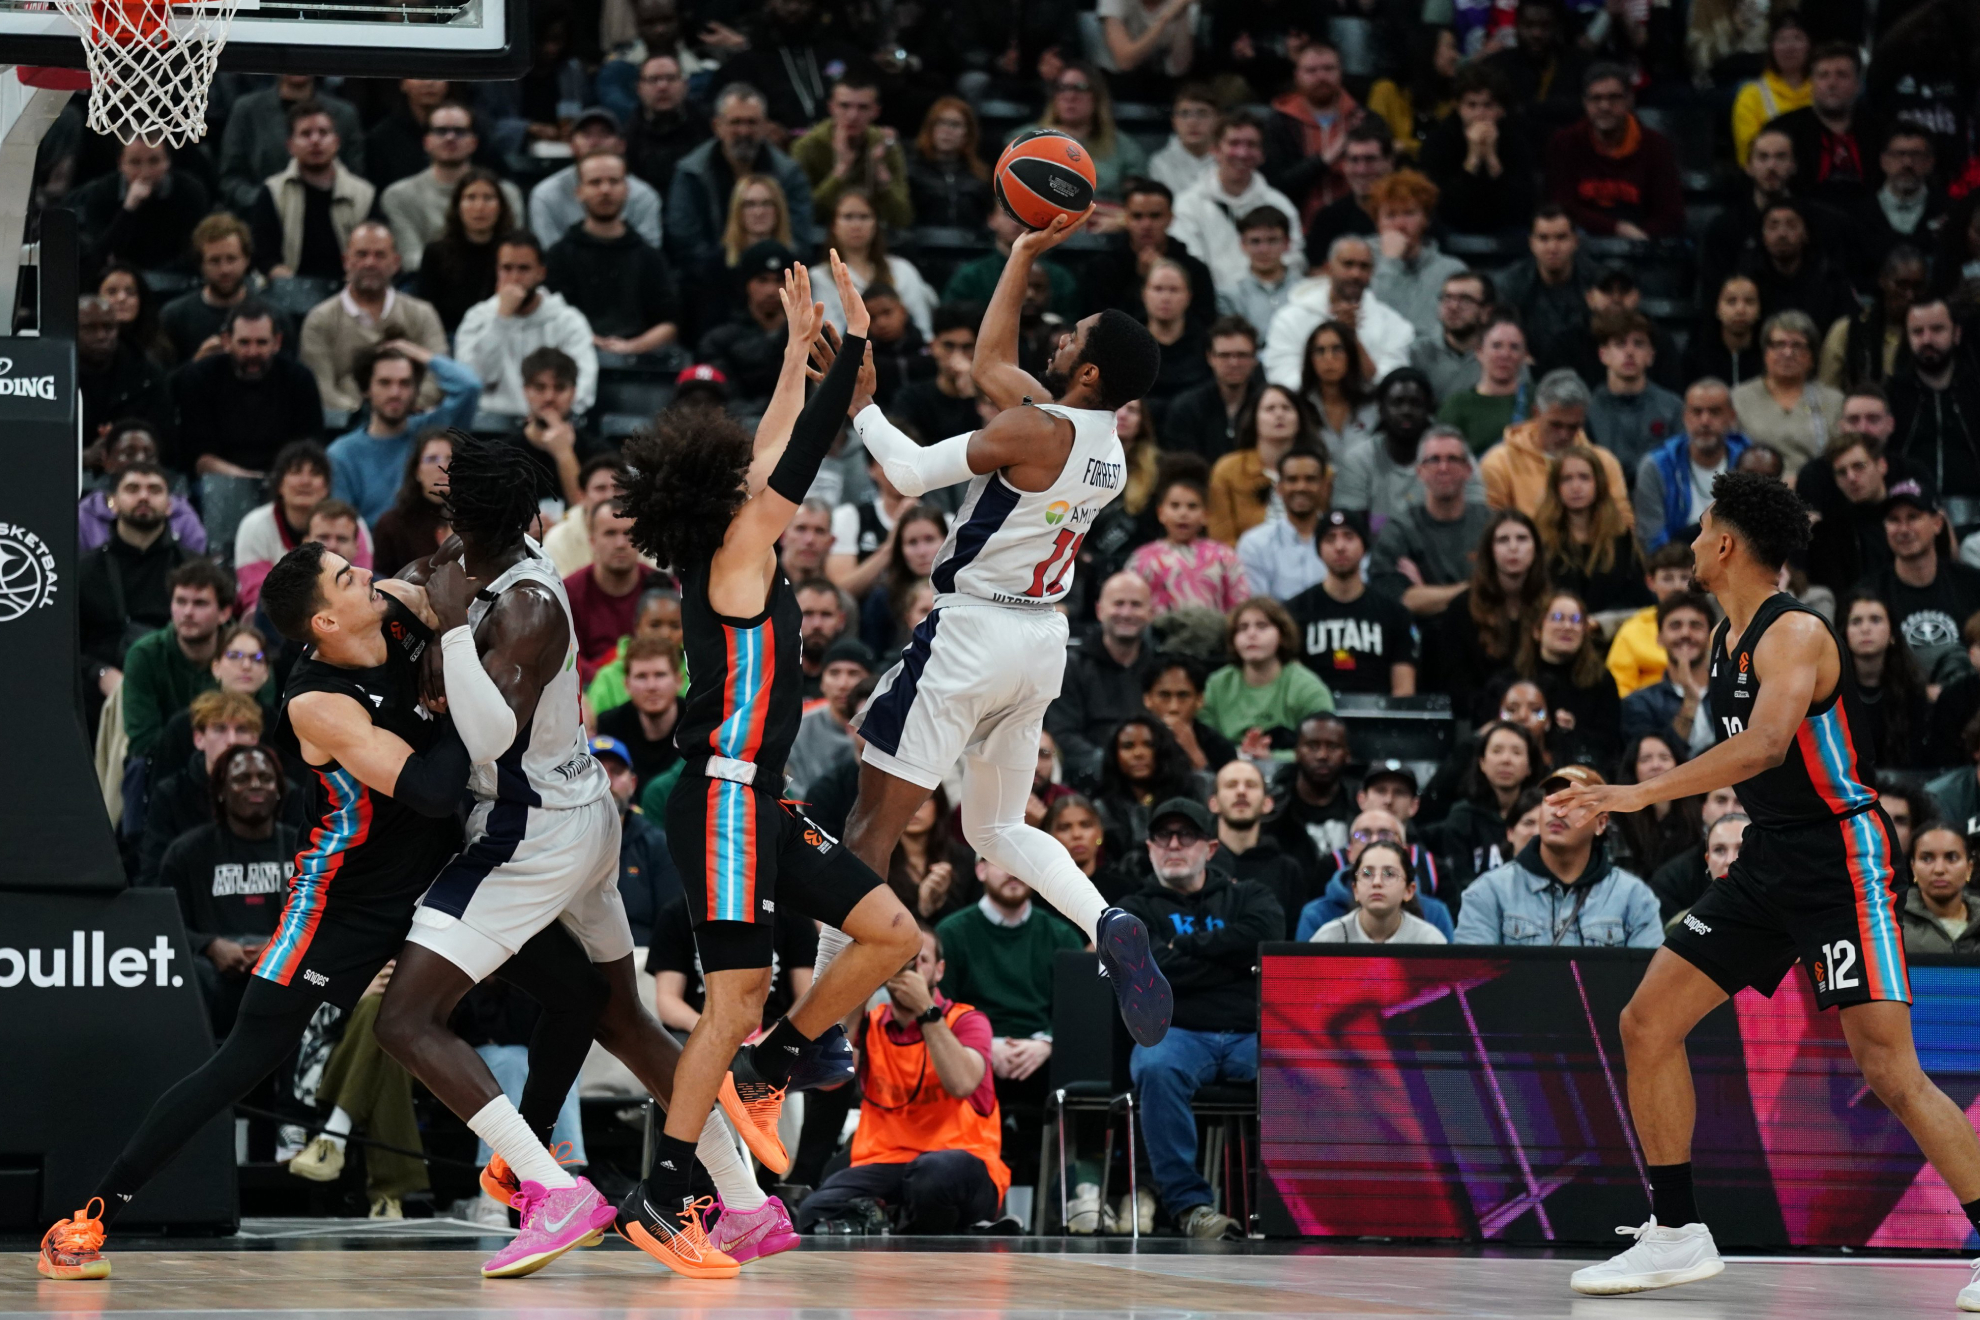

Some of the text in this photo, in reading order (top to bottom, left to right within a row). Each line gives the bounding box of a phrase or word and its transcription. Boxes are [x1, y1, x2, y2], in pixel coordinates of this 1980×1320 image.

[1082, 457, 1121, 490] FORREST
[1306, 618, 1383, 656] UTAH
[1683, 914, 1712, 936] snipes
[1821, 939, 1860, 991] 12
